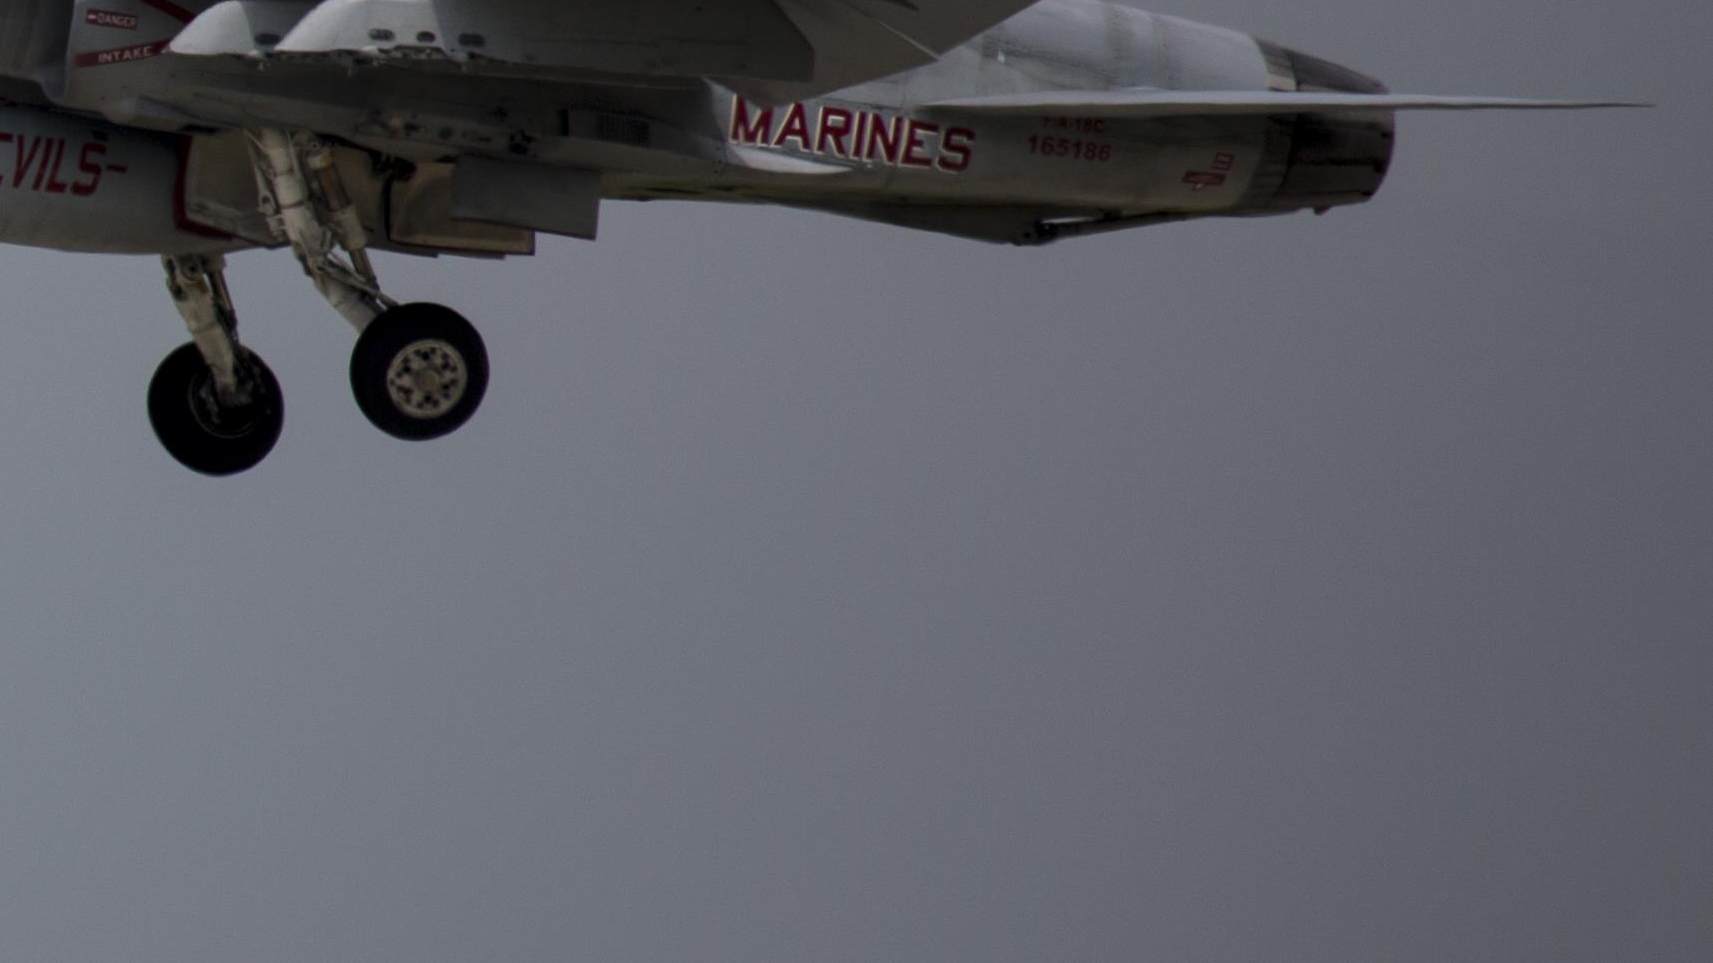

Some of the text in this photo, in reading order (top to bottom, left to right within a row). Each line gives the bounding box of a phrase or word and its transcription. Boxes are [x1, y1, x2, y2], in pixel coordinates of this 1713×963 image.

[97, 13, 136, 27] DANGER
[98, 46, 152, 63] INTAKE
[727, 92, 977, 174] MARINES
[1028, 134, 1112, 162] 165186
